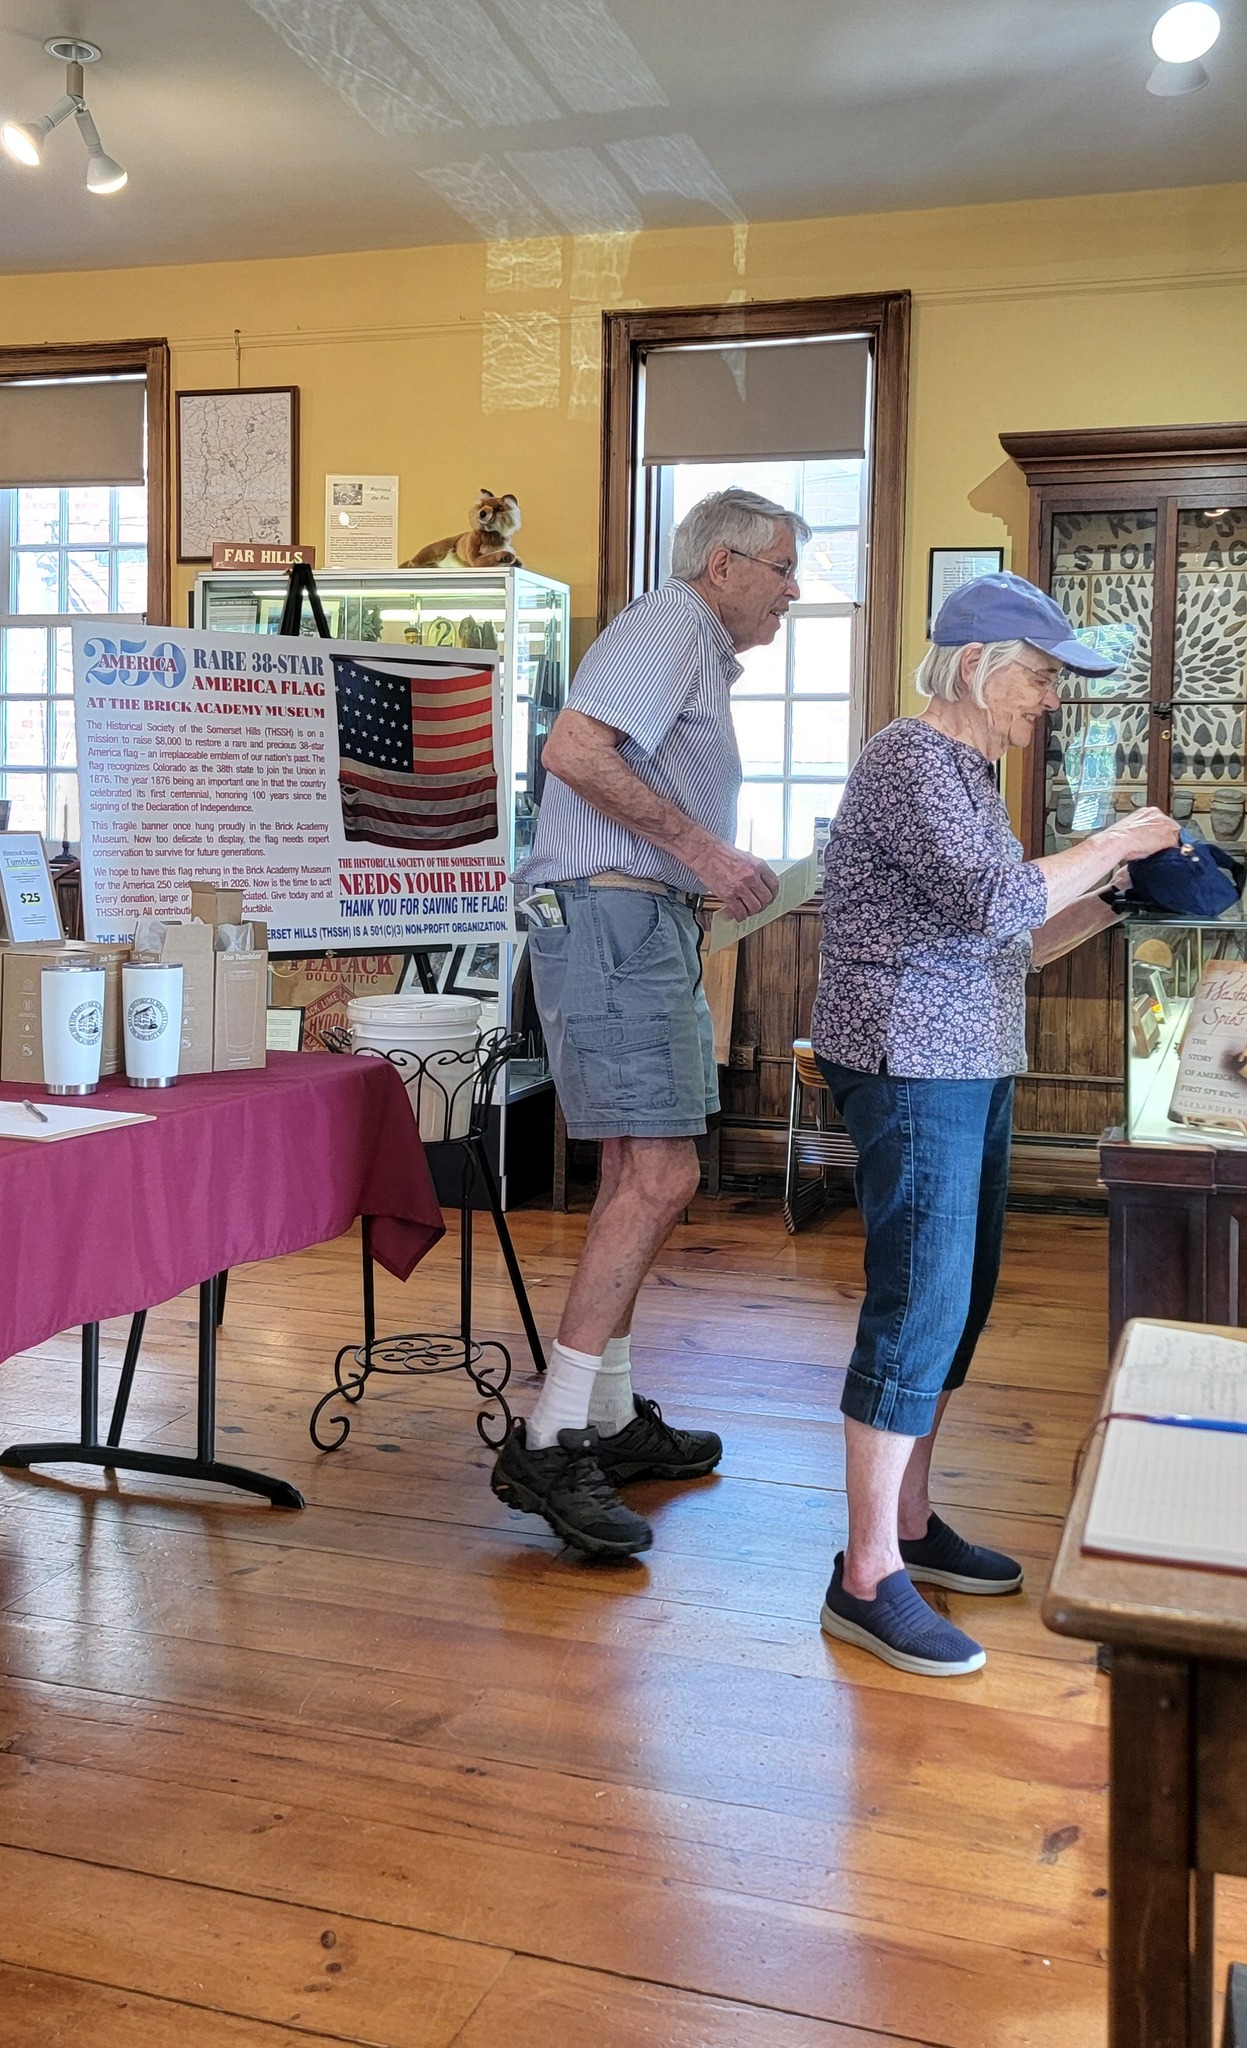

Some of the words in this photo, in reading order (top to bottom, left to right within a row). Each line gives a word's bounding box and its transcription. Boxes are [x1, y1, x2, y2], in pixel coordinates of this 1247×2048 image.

[224, 549, 254, 563] FAR
[261, 550, 303, 564] HILLS
[1203, 540, 1247, 570] AG
[436, 621, 453, 647] 2
[83, 637, 187, 688] 250
[99, 654, 177, 672] AMERICA
[192, 648, 247, 671] RARE
[252, 652, 325, 676] 38-STAR
[193, 675, 277, 694] AMERICA
[281, 680, 325, 696] FLAG
[86, 697, 106, 710] AT
[108, 698, 140, 711] THE
[143, 699, 192, 714] BRICK
[194, 702, 264, 716] ACADEMY
[265, 705, 325, 719] MUSEUM
[86, 720, 102, 730] The
[106, 720, 142, 731] Historical
[147, 722, 175, 735] Society
[179, 723, 186, 733] of
[190, 724, 202, 733] the
[206, 724, 242, 735] Somerset
[246, 726, 261, 735] Hills
[264, 726, 294, 738] (THSSH)
[297, 728, 304, 737] is
[320, 730, 324, 738] a
[88, 747, 121, 757] America
[123, 748, 138, 760] flag
[159, 749, 208, 762] irreplaceable
[210, 751, 240, 760] emblem
[242, 752, 249, 760] of
[264, 752, 292, 762] nation's
[294, 753, 310, 764] past.
[312, 754, 325, 762] The
[88, 761, 104, 772] flag
[107, 762, 150, 773] recognizes
[152, 763, 186, 772] Colorado
[201, 764, 214, 773] the
[216, 764, 233, 773] 38th
[236, 765, 254, 774] state
[256, 765, 264, 774] to
[266, 766, 280, 776] join
[282, 766, 294, 774] the
[296, 766, 316, 775] Union
[319, 767, 326, 775] in
[90, 788, 132, 798] celebrated
[136, 788, 146, 798] its
[150, 789, 166, 798] first
[170, 789, 212, 800] centennial,
[215, 790, 248, 801] honoring
[252, 790, 266, 799] 100
[269, 793, 290, 802] years
[293, 791, 312, 800] since
[315, 792, 327, 800] the
[90, 802, 120, 813] signing
[121, 802, 130, 811] of
[131, 802, 144, 811] the
[146, 802, 189, 812] Declaration
[190, 803, 198, 812] of
[200, 803, 254, 814] Independence.
[91, 821, 108, 830] This
[112, 821, 137, 832] fragile
[141, 821, 169, 830] banner
[195, 821, 214, 832] hung
[218, 821, 246, 832] proudly
[249, 821, 256, 830] in
[260, 821, 272, 830] the
[275, 822, 294, 830] Brick
[296, 822, 328, 832] Academy
[93, 848, 144, 857] conservation
[145, 848, 153, 856] to
[155, 848, 183, 856] survive
[184, 848, 195, 856] for
[197, 848, 219, 856] future
[221, 848, 266, 859] generations.
[5, 857, 40, 866] Tumblers
[338, 858, 353, 869] THE
[353, 857, 396, 868] HISTORICAL
[396, 857, 425, 868] SOCIETY
[426, 856, 435, 867] OF
[436, 856, 450, 867] THE
[450, 856, 486, 867] SOMERSET
[486, 856, 506, 866] HILLS
[93, 867, 106, 876] We
[108, 867, 129, 878] hope
[130, 867, 139, 876] to
[141, 867, 160, 876] have
[162, 867, 176, 876] this
[178, 867, 193, 878] flag
[194, 866, 222, 877] rehung
[223, 866, 230, 875] in
[232, 866, 244, 875] the
[246, 866, 265, 875] Brick
[266, 866, 299, 876] Academy
[301, 866, 332, 874] Museum
[339, 872, 401, 896] NEEDS
[404, 871, 456, 894] YOUR
[460, 871, 506, 892] HELP
[20, 892, 41, 904] $25
[339, 898, 374, 917] THANK
[377, 898, 397, 916] YOU
[400, 898, 420, 915] FOR
[422, 897, 458, 915] SAVING
[460, 896, 479, 913] THE
[481, 896, 508, 913] FLAG!
[268, 928, 292, 940] ERSET
[294, 927, 317, 939] HILLS
[320, 926, 351, 940] (THSSH)
[353, 926, 360, 937] IS
[363, 926, 368, 936] A
[370, 924, 403, 936] 501(C)(3)
[405, 922, 450, 935] NON-PROFIT
[452, 920, 508, 933] ORGANIZATION.
[306, 973, 379, 984] DOLOMITIC
[321, 992, 339, 1012] LIME
[1202, 1007, 1245, 1035] Spies
[1192, 1038, 1207, 1046] THE
[1187, 1053, 1212, 1062] STORY
[1184, 1069, 1196, 1077] OF
[1180, 1084, 1202, 1094] FIRST
[1203, 1088, 1218, 1096] SPY
[1219, 1090, 1240, 1099] RING
